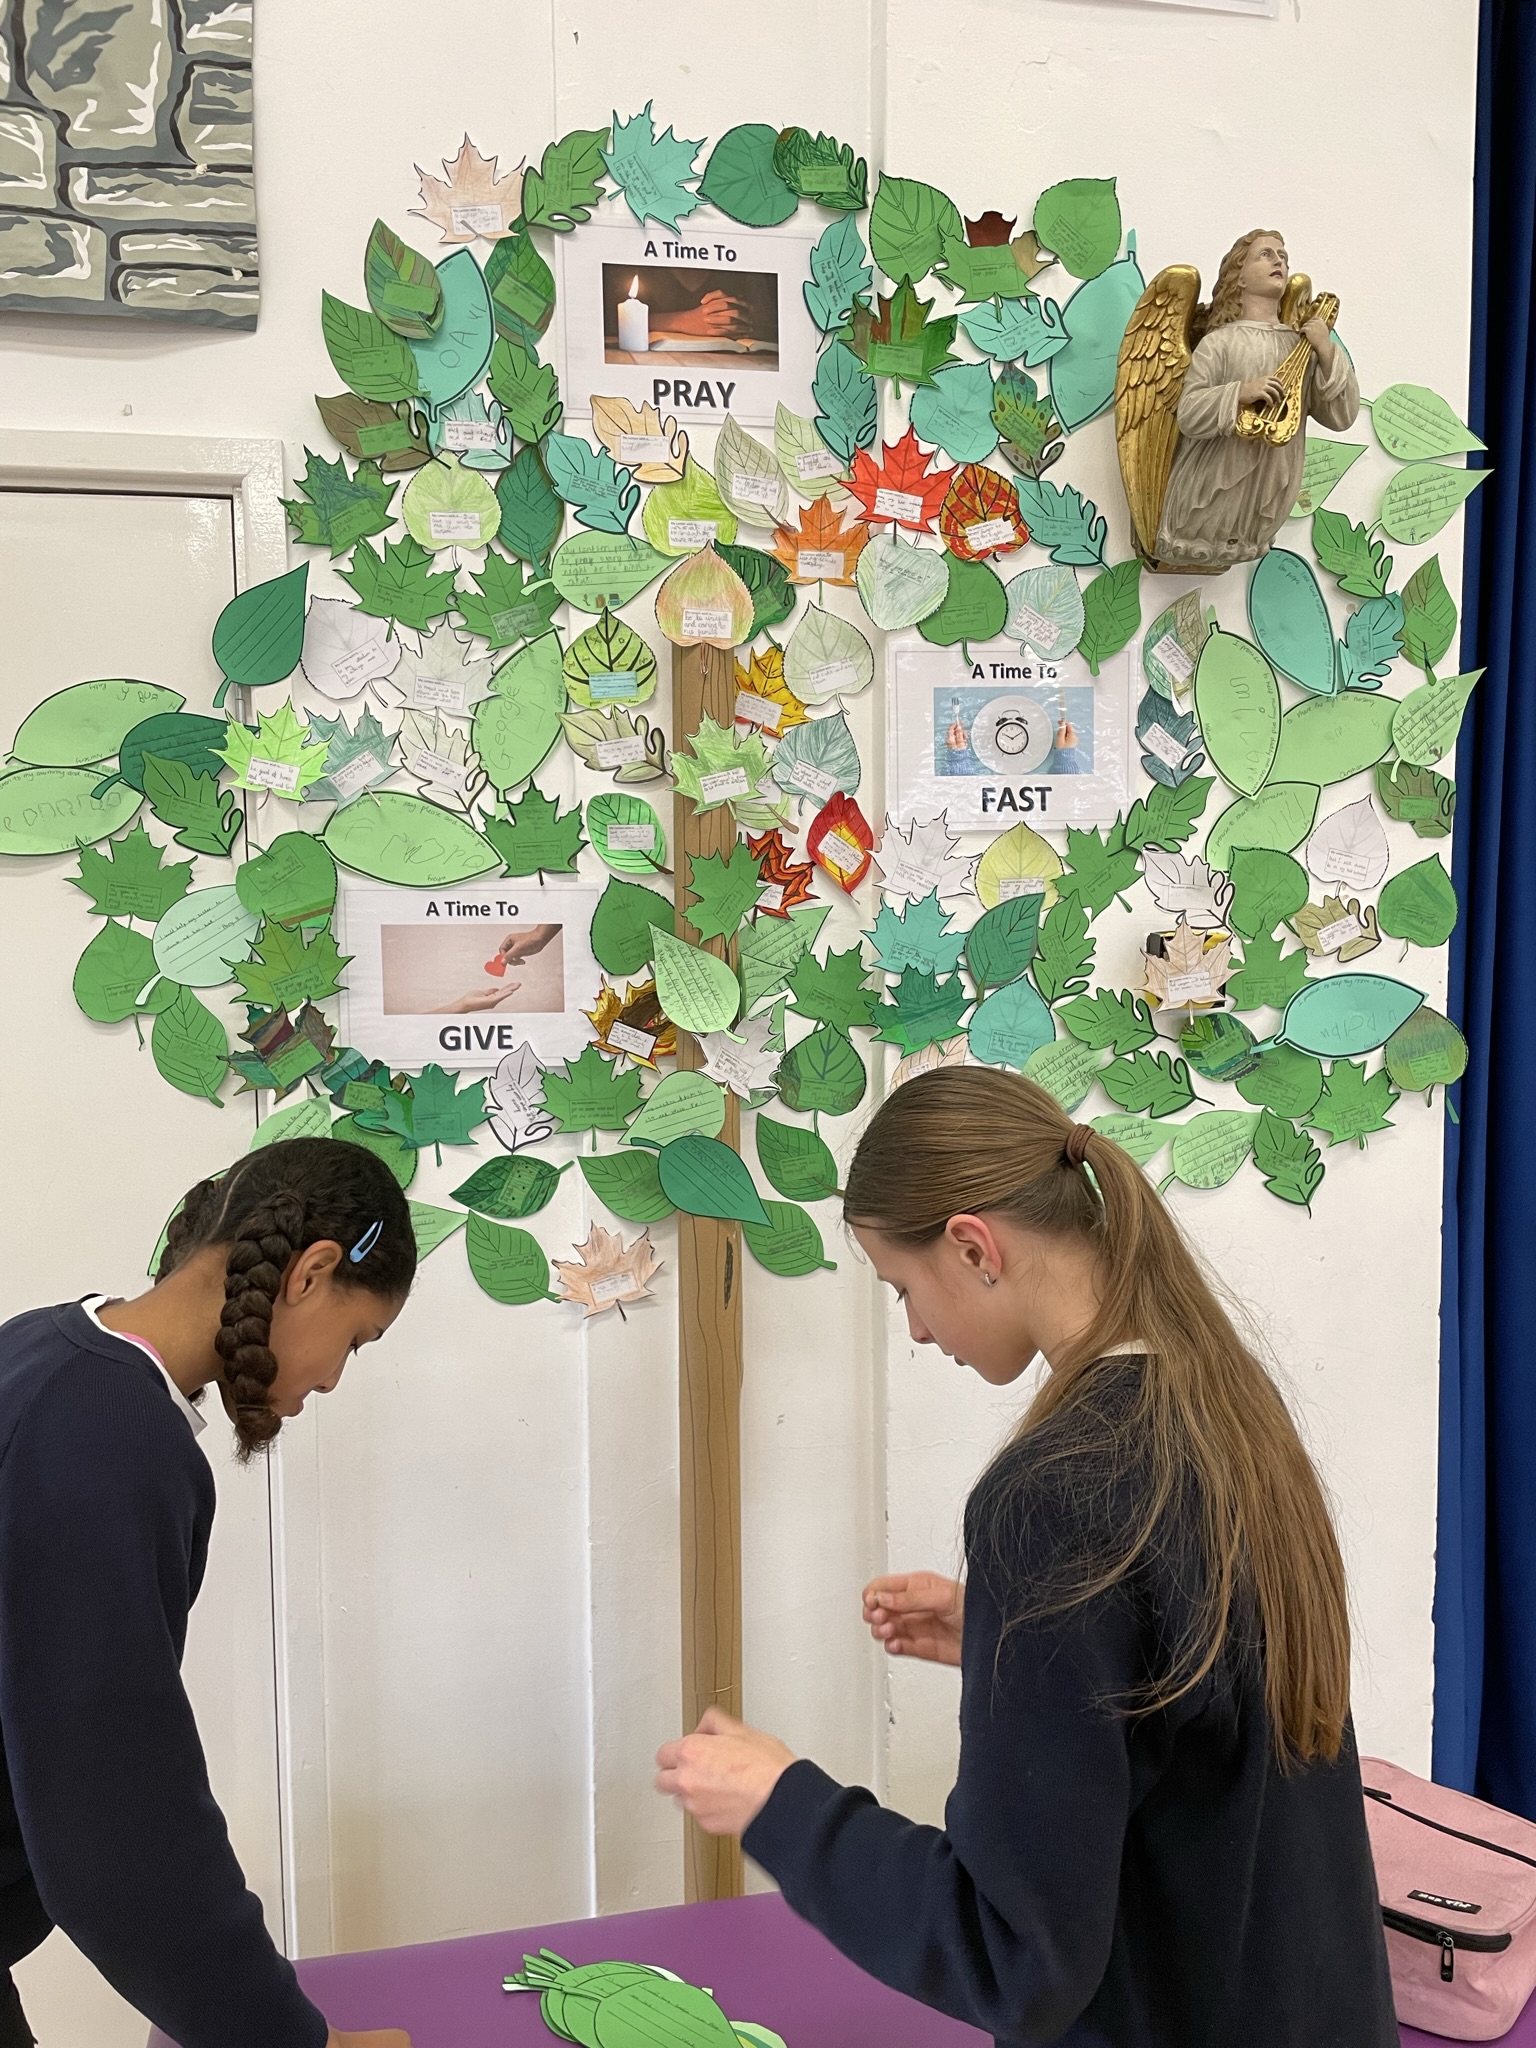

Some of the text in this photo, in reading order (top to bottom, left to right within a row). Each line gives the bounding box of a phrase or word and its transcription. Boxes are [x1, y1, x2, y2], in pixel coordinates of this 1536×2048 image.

[644, 241, 737, 262] A Time To
[653, 379, 736, 408] PRAY
[972, 664, 1058, 680] A Time To
[981, 786, 1052, 813] FAST
[425, 901, 519, 917] A Time To
[439, 1025, 514, 1051] GIVE
